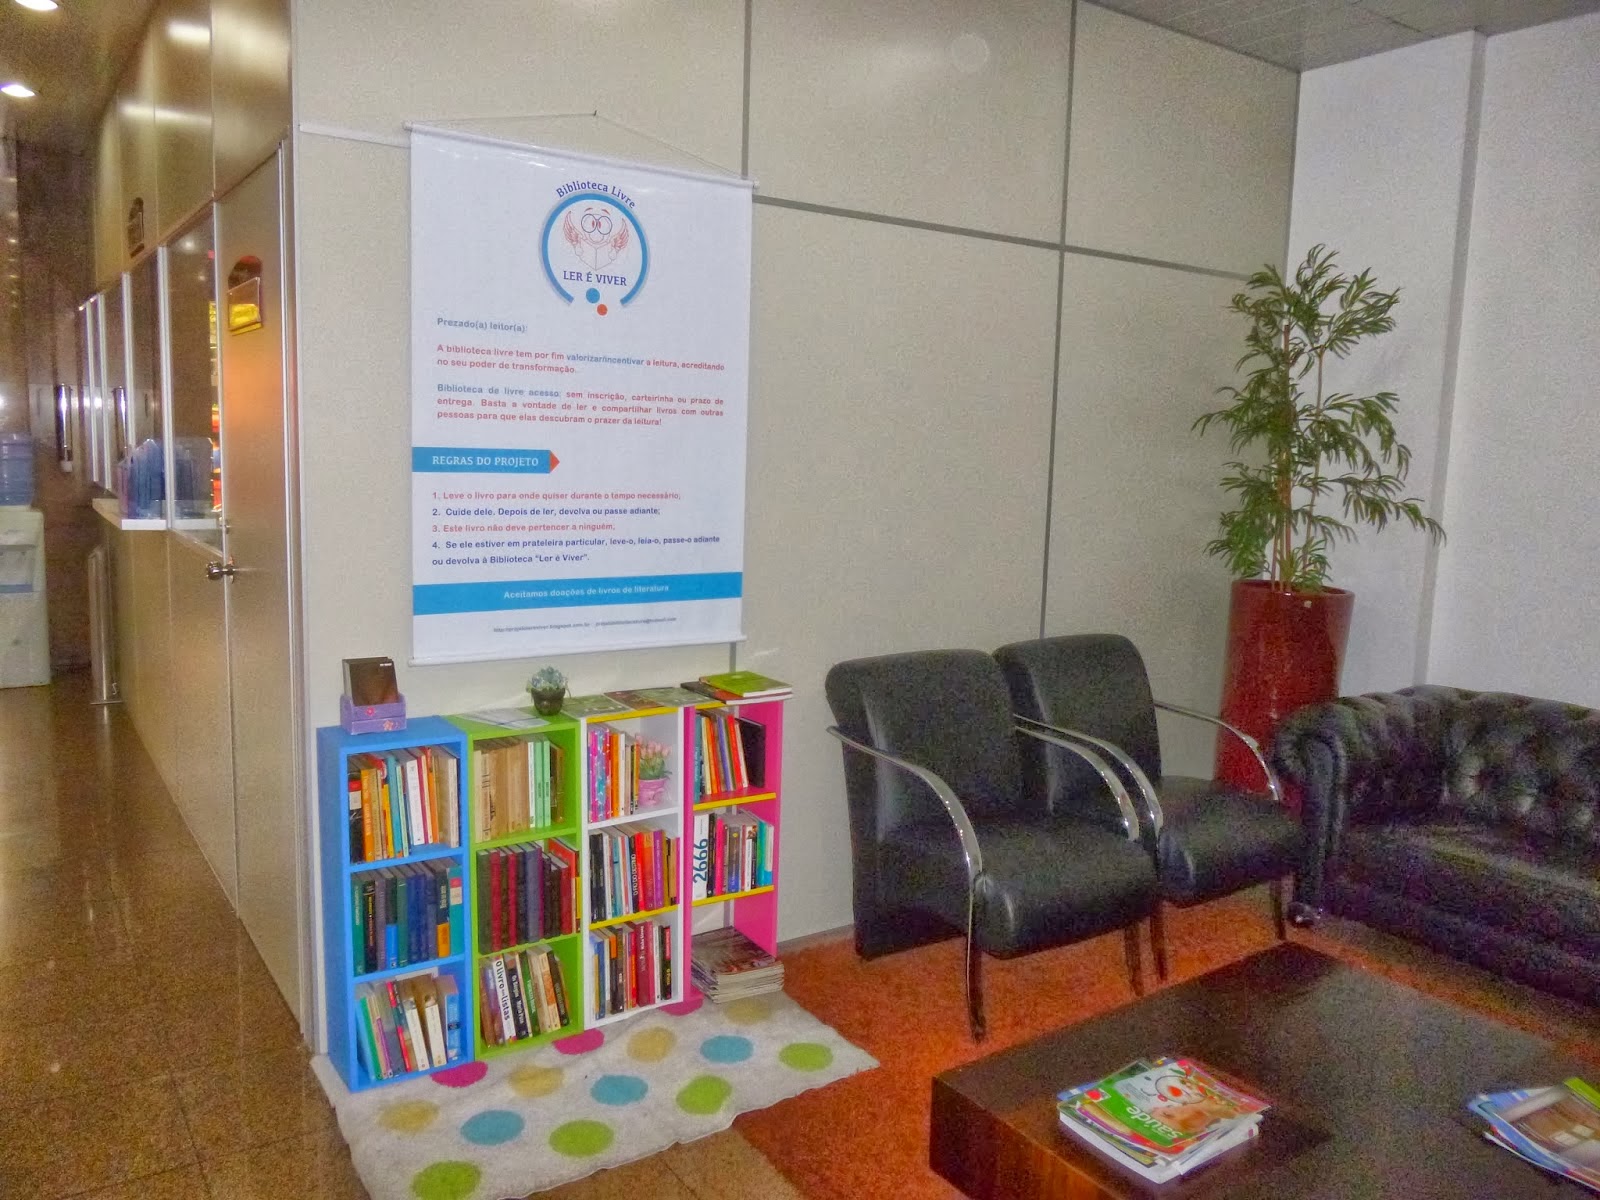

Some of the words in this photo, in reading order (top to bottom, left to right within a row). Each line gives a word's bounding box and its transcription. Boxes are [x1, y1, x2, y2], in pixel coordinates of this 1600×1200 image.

[556, 181, 608, 198] Biblioteca
[611, 186, 635, 209] Livre
[564, 270, 583, 281] LER
[586, 272, 592, 282] É
[596, 274, 627, 286] VIVER
[437, 318, 488, 330] Prezado(a)
[437, 344, 444, 352] A
[446, 346, 492, 355] biblioteca
[494, 348, 513, 357] livre
[516, 350, 532, 358] tem
[534, 352, 549, 360] por
[552, 352, 564, 360] fim
[653, 360, 680, 368] leitura,
[682, 362, 725, 371] acreditando
[470, 360, 496, 369] poder
[438, 384, 483, 394] Biblioteca
[488, 386, 499, 394] de
[504, 388, 524, 396] livre
[588, 392, 627, 401] inscrição,
[632, 394, 673, 403] carteirinha
[690, 398, 711, 406] prazo
[481, 399, 506, 407] Basta
[522, 402, 557, 410] vontade
[562, 402, 572, 410] de
[602, 406, 652, 414] compartilhar
[700, 408, 724, 416] outras
[437, 411, 474, 419] pessoas
[477, 413, 498, 421] para
[500, 414, 516, 422] que
[538, 414, 585, 423] descubram
[622, 417, 633, 425] da
[634, 418, 662, 426] leitura!
[432, 456, 474, 465] REGRAS
[476, 457, 491, 465] DO
[494, 457, 539, 467] PROJETO
[496, 493, 517, 501] para
[542, 492, 568, 501] quiser
[571, 492, 602, 500] durante
[611, 492, 635, 501] tempo
[432, 508, 440, 516] 2.
[446, 508, 472, 516] Cuide
[474, 508, 495, 516] dele.
[498, 508, 528, 517] Depois
[543, 508, 557, 517] ler,
[444, 524, 463, 532] Este
[466, 524, 485, 532] livro
[488, 524, 503, 532] não
[528, 524, 569, 532] pertencer
[460, 541, 473, 549] ele
[476, 540, 504, 548] estiver
[522, 540, 564, 548] prateleira
[566, 538, 608, 547] particular,
[610, 538, 636, 546] leve-o,
[664, 537, 692, 545] passe-o
[446, 556, 480, 565] devolva
[490, 555, 533, 564] Biblioteca
[504, 591, 548, 599] Aceitamos
[551, 588, 585, 597] doações
[634, 585, 669, 593] literatura
[692, 838, 709, 884] 2666
[497, 969, 505, 989] livro
[502, 996, 510, 1020] listas
[1126, 1105, 1184, 1140] saúde
